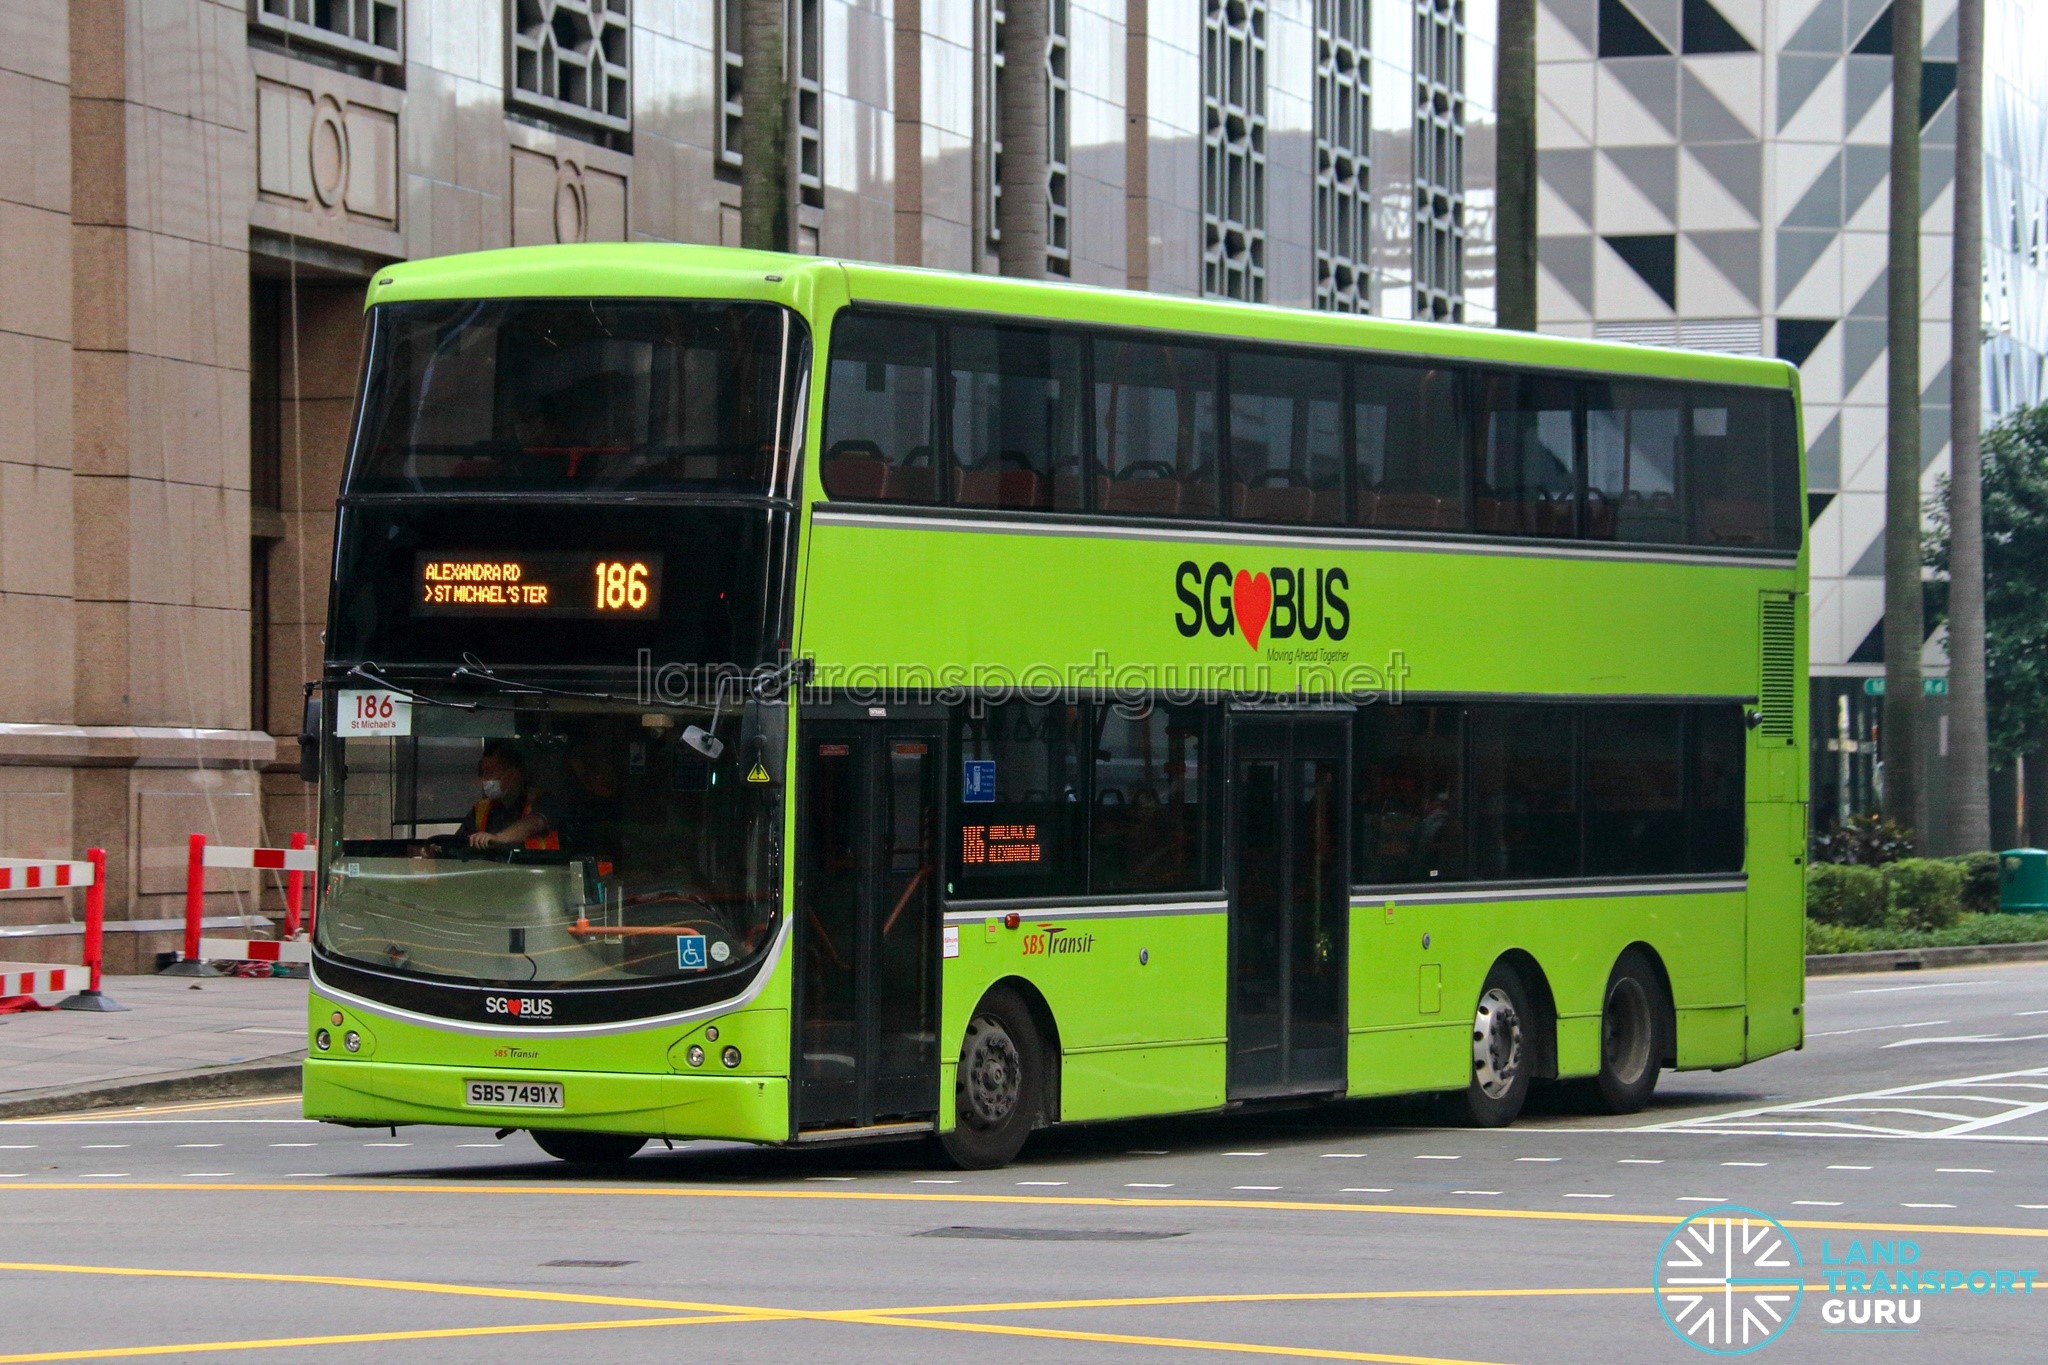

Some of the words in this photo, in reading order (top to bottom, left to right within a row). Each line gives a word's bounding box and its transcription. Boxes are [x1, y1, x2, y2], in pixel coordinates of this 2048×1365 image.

[425, 563, 501, 581] ALEXANDRA
[503, 564, 521, 581] RD
[453, 585, 520, 603] MICHAEL'S
[522, 586, 548, 603] TER
[596, 563, 648, 609] 186
[1266, 648, 1293, 664] Moving
[1294, 648, 1318, 661] Ahead
[1319, 648, 1350, 665] Together
[356, 695, 393, 718] 186
[351, 720, 360, 729] St
[361, 720, 396, 729] Michael's
[1022, 934, 1045, 956] SBS
[1043, 928, 1096, 957] Transit
[494, 1049, 508, 1057] SBS
[508, 1047, 539, 1058] Transit
